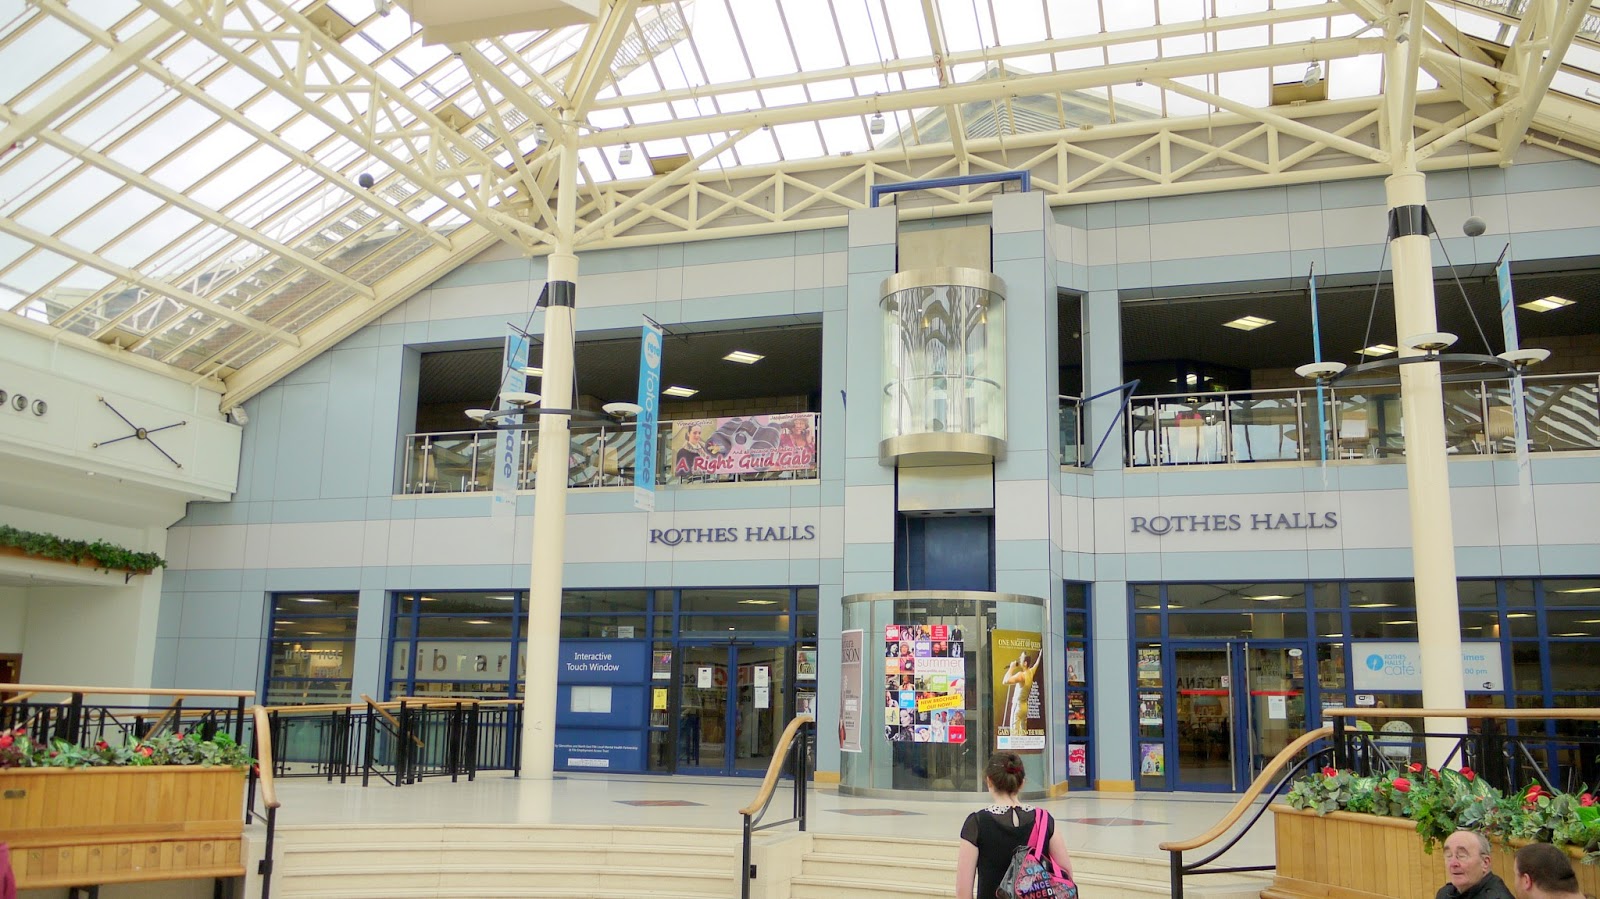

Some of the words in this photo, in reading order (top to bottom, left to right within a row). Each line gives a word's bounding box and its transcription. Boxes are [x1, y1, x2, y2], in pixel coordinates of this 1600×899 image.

[642, 370, 659, 485] fotospace
[675, 458, 689, 471] A
[693, 455, 734, 473] Right
[738, 452, 775, 470] Guid
[778, 450, 812, 466] Gab
[1131, 514, 1242, 536] ROTHES
[1250, 511, 1338, 530] HALLS
[649, 527, 739, 546] ROTHES
[744, 524, 816, 542] HALLS
[574, 652, 613, 661] Interactive
[917, 658, 962, 668] summer
[566, 662, 588, 671] Touch
[589, 662, 620, 671] Window
[1384, 661, 1415, 676] café
[933, 695, 958, 704] BROCHURE
